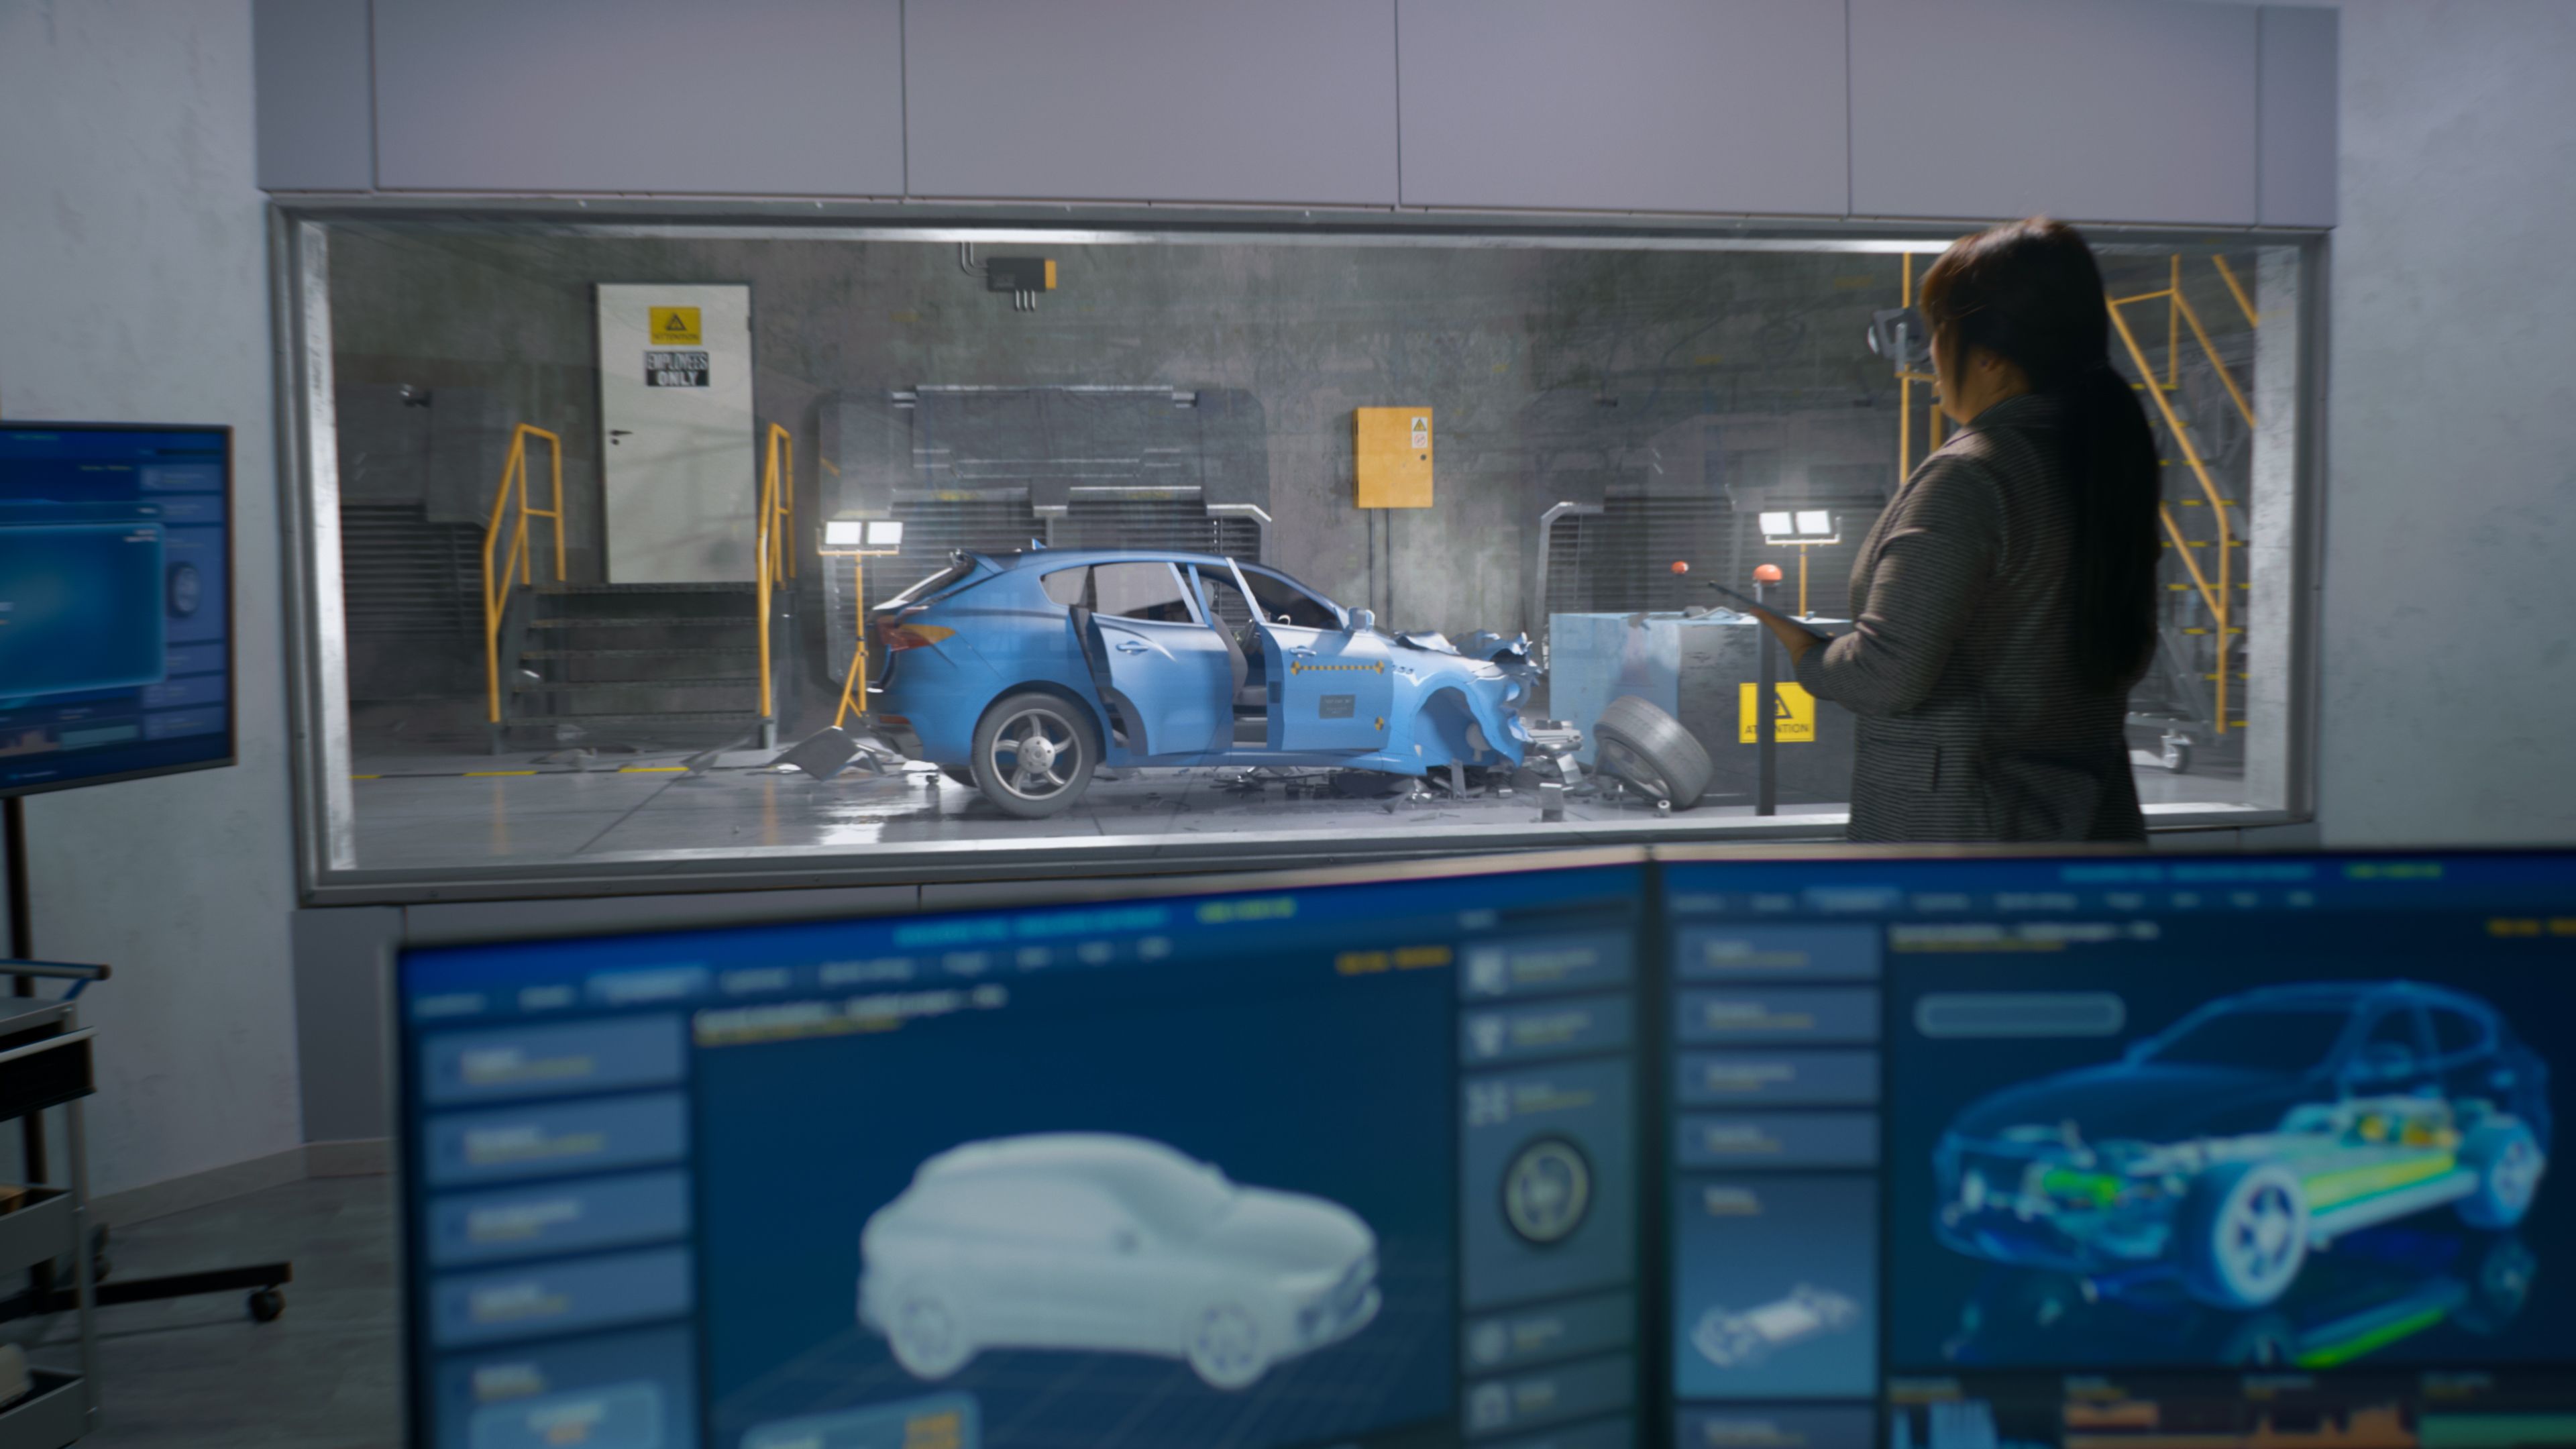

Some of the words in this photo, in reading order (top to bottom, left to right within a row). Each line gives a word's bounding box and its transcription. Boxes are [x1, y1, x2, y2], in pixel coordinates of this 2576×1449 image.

[647, 353, 708, 370] EMPLOYEES
[657, 370, 698, 386] ONLY
[1746, 724, 1809, 734] ATNTION
